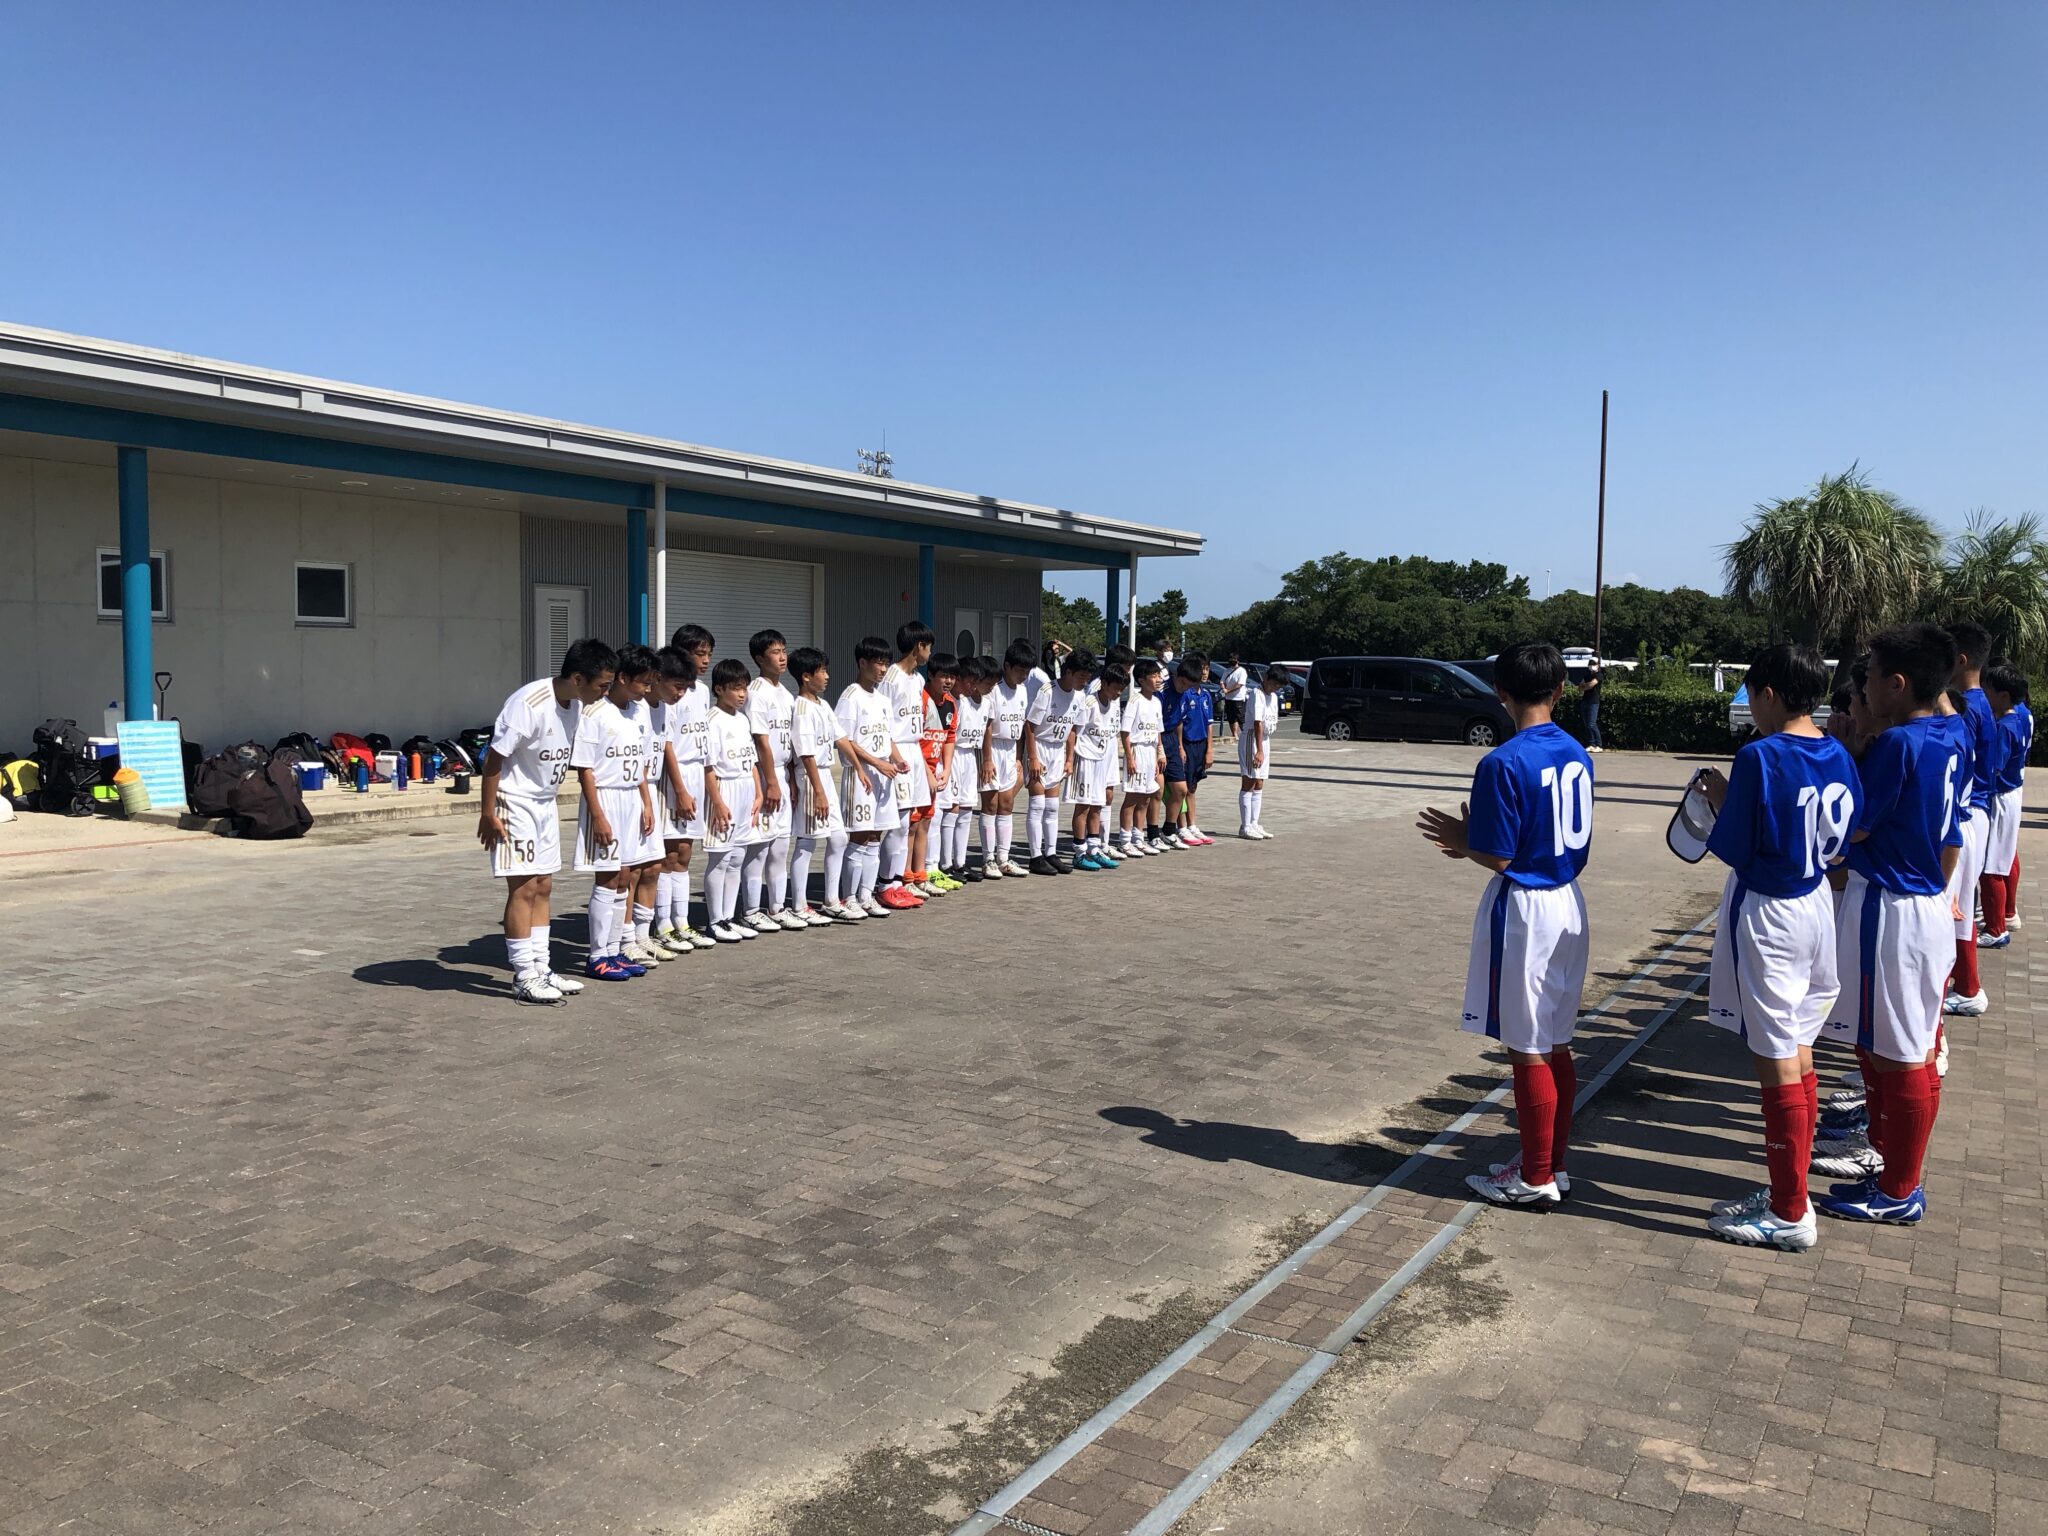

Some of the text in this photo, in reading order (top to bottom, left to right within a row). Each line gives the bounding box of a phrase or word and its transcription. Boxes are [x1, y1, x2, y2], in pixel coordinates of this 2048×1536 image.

[1053, 724, 1066, 740] 46
[695, 735, 708, 756] 43
[550, 763, 567, 785] 58
[623, 760, 639, 782] 52
[855, 804, 871, 822] 38
[1541, 761, 1593, 857] 10
[514, 840, 535, 862] 58
